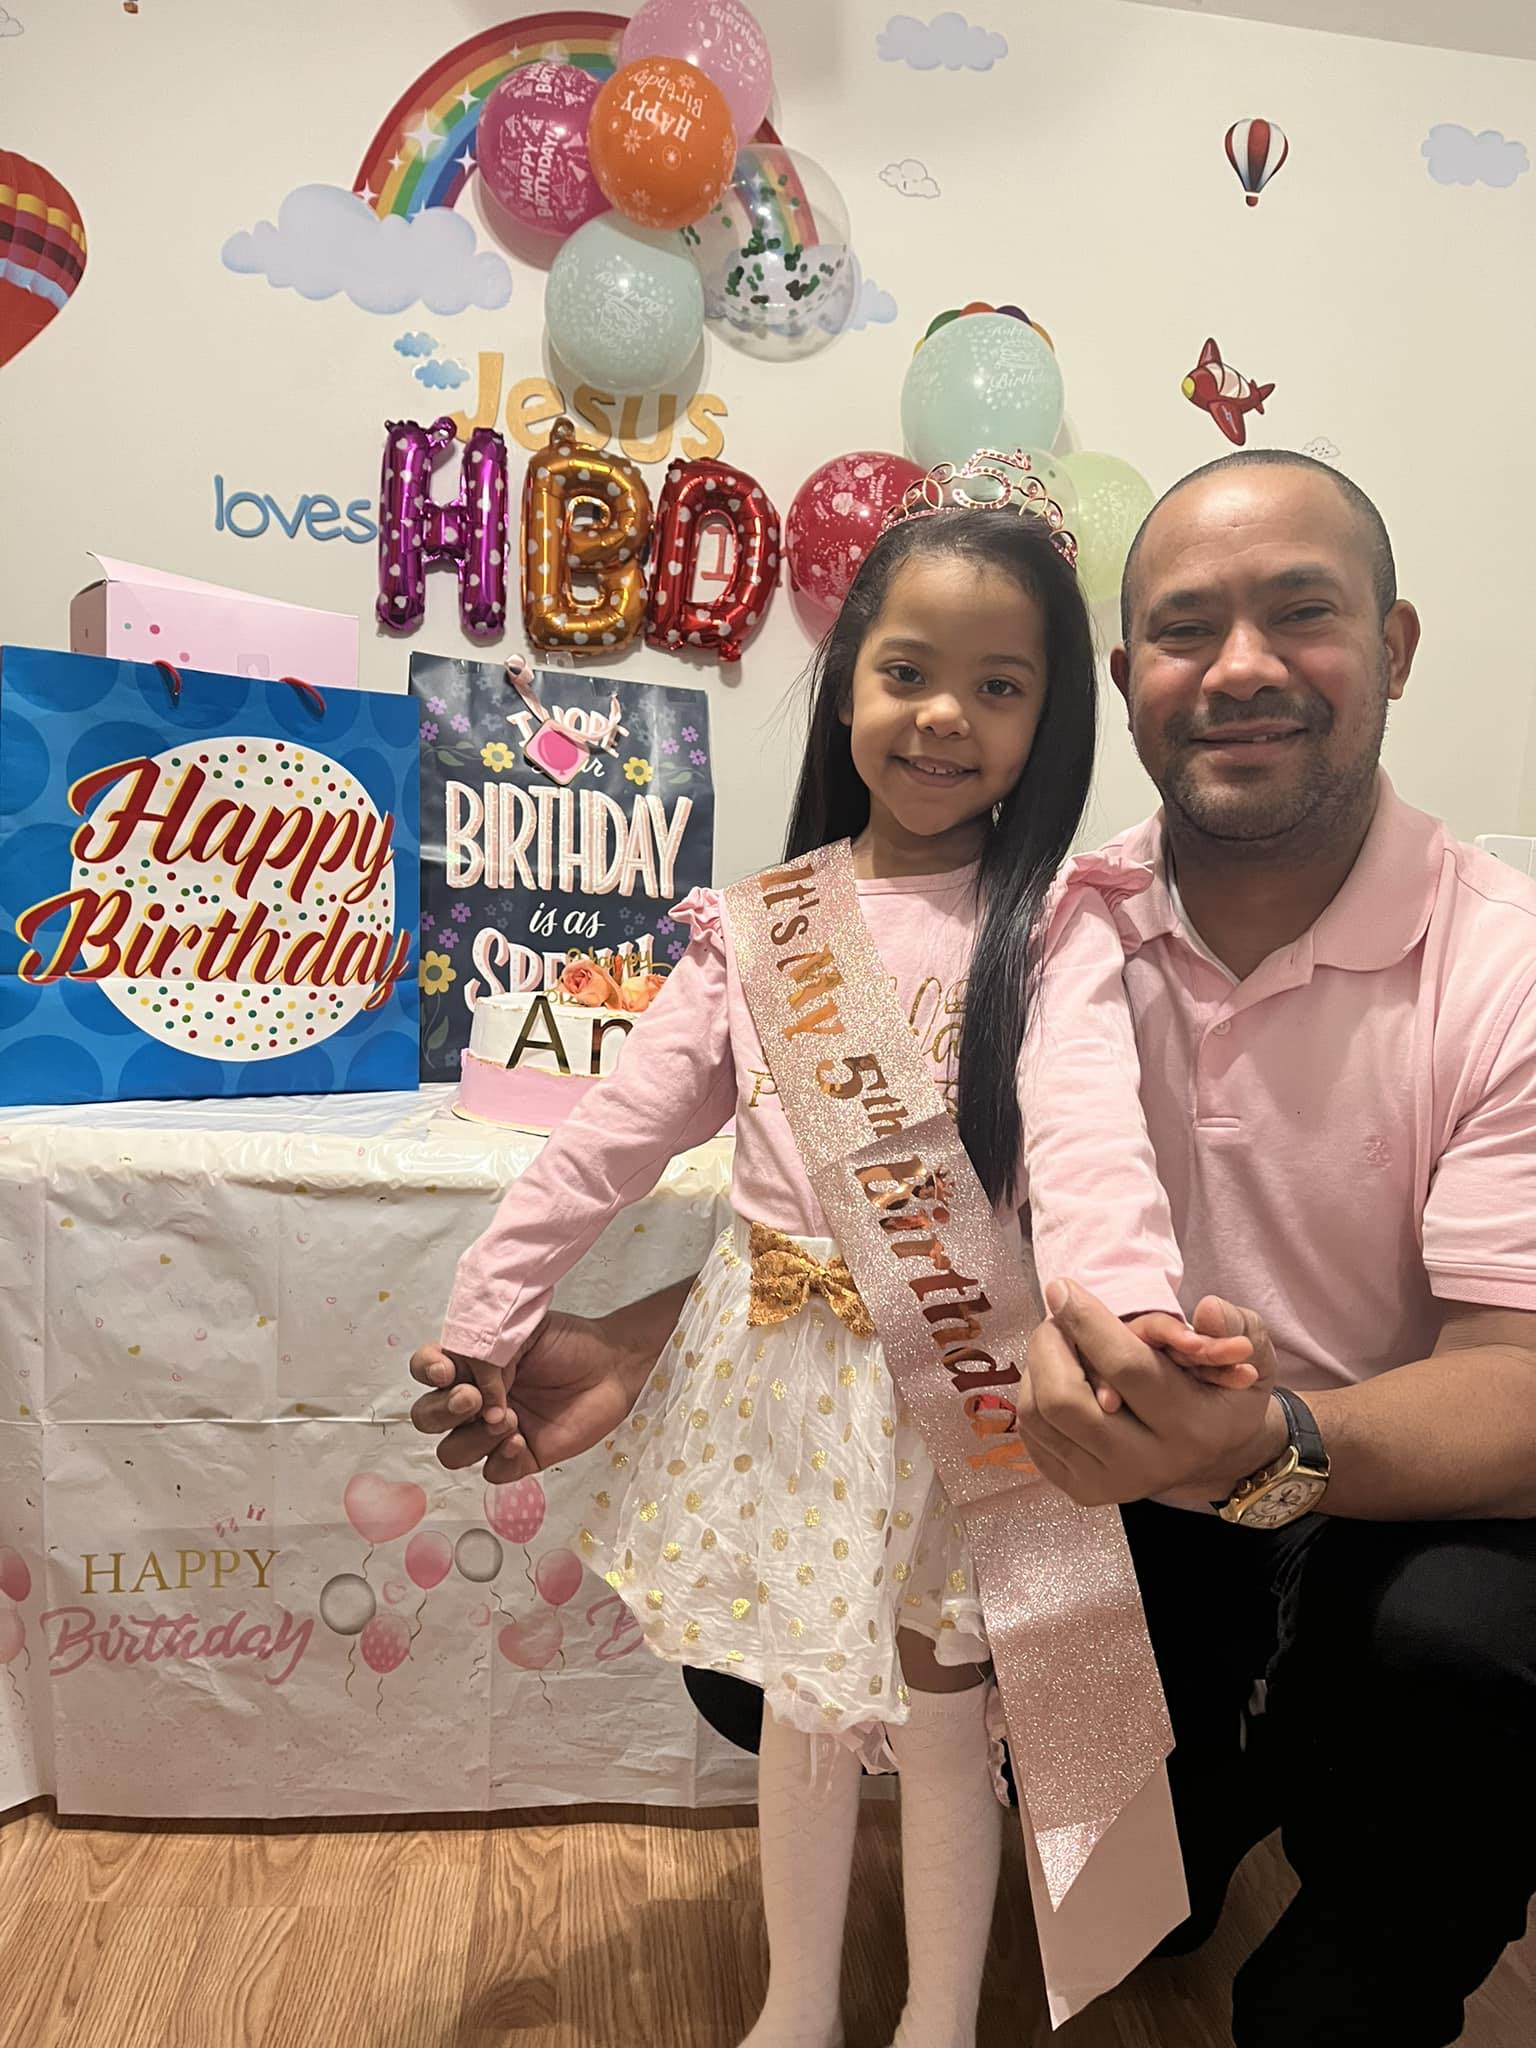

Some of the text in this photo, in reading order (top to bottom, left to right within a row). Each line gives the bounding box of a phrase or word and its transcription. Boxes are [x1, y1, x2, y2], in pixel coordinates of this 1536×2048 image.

[620, 90, 692, 142] HAPPY
[520, 140, 539, 202] HAPPY
[452, 351, 728, 464] Jesus
[214, 475, 377, 544] loves
[376, 415, 781, 662] HBD
[66, 756, 396, 905] Happy
[444, 780, 693, 900] BIRTHDAY
[14, 886, 412, 1013] Birthday
[529, 902, 606, 939] is as
[815, 1053, 909, 1139] 5th
[80, 1549, 281, 1594] HAPPY
[39, 1606, 315, 1686] Birthday
